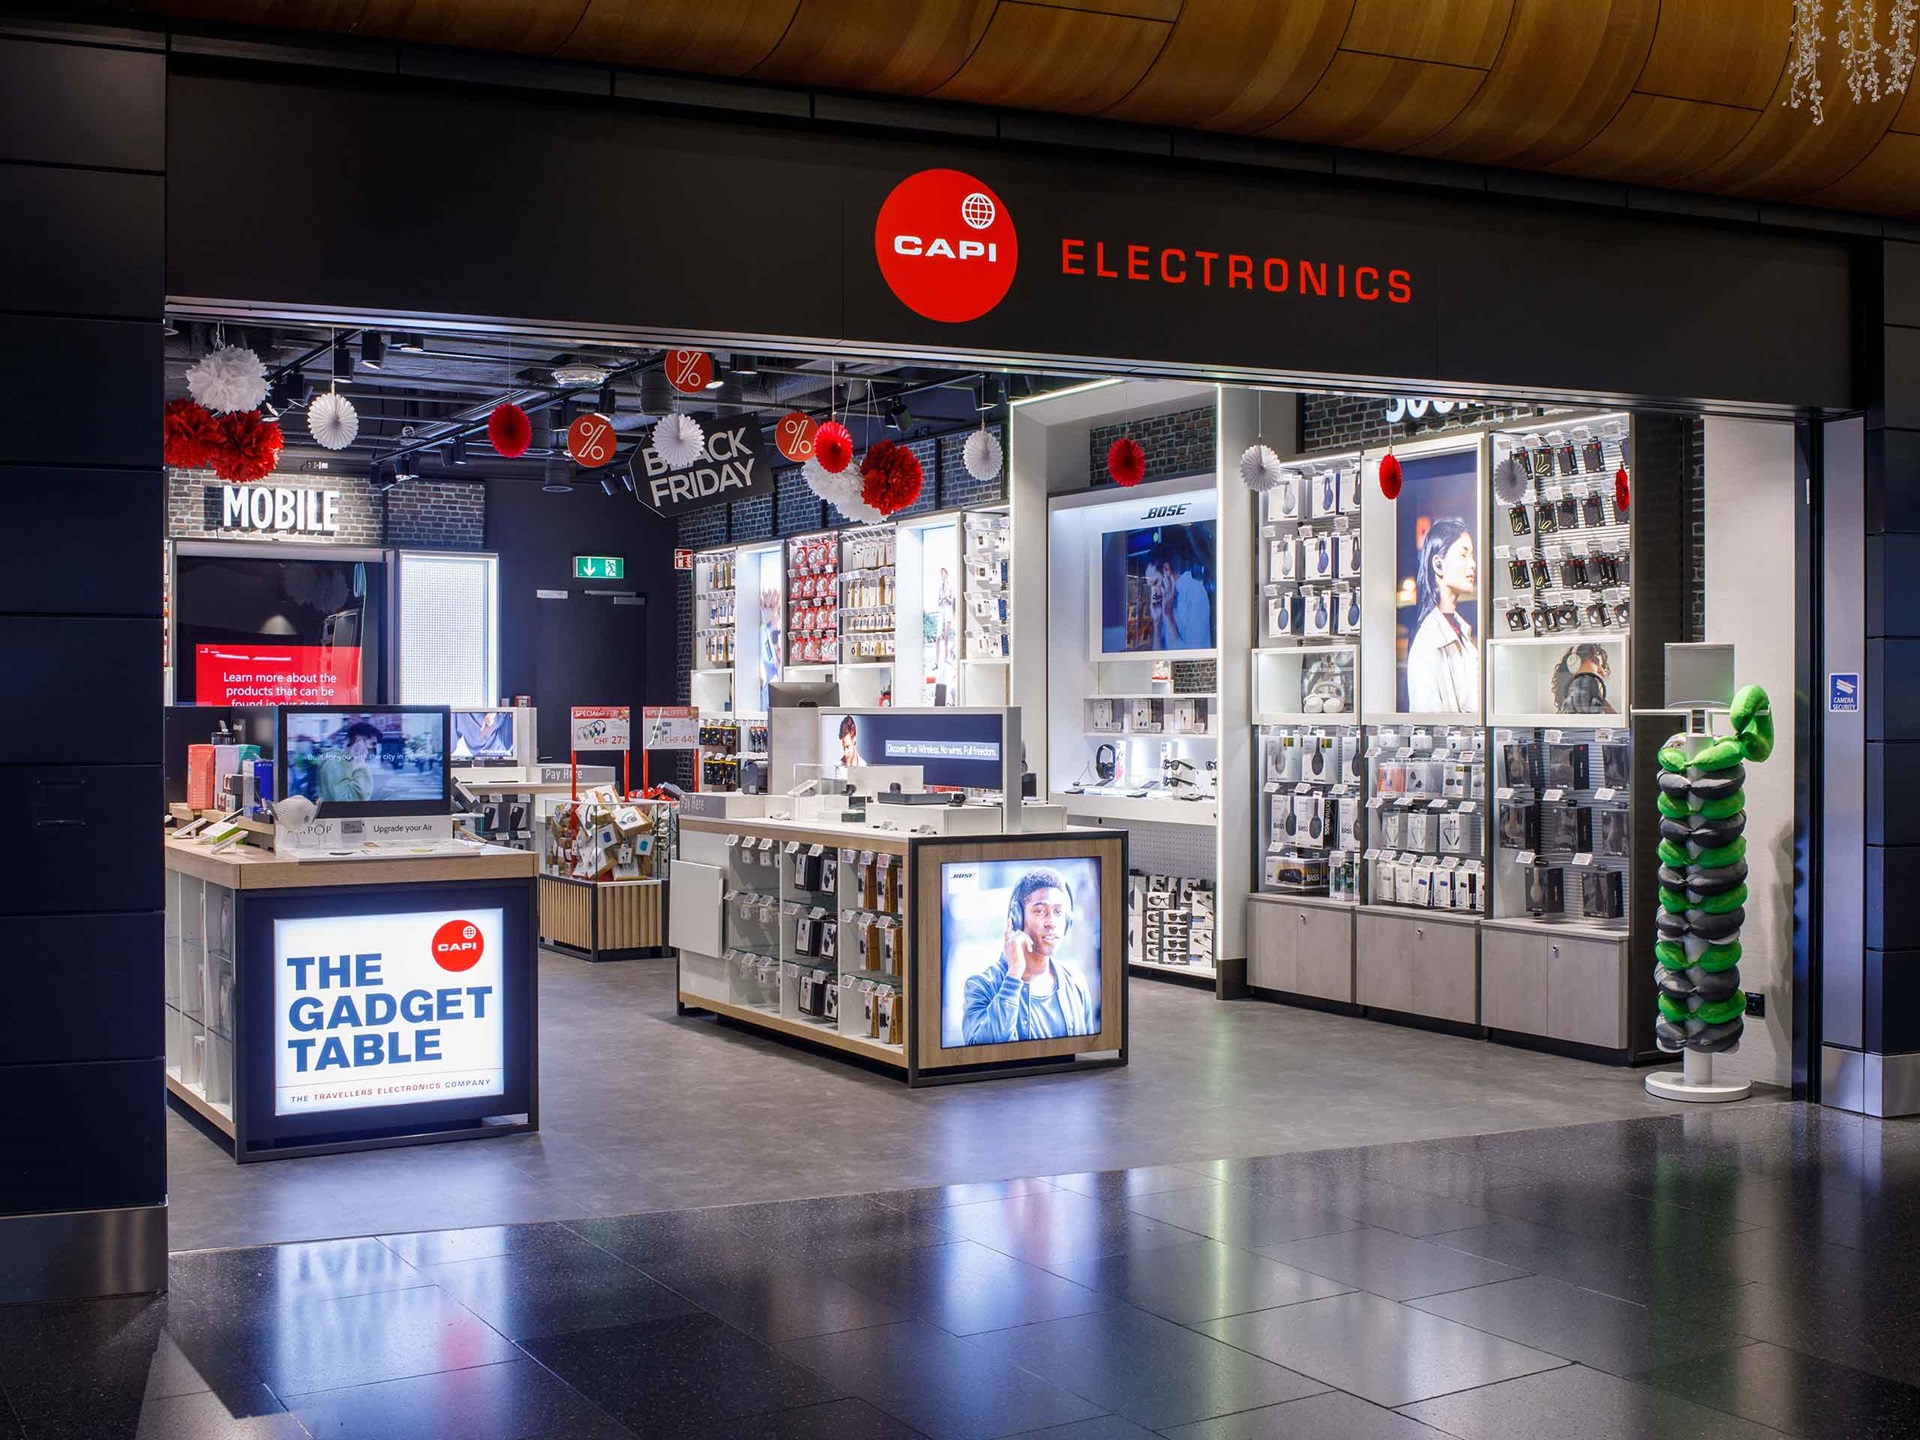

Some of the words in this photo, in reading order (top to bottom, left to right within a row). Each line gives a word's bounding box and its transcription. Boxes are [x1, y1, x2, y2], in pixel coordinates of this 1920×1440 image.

[894, 234, 996, 262] CAPI
[1061, 239, 1412, 303] ELECTRONICS
[642, 427, 753, 476] BCK
[650, 458, 755, 507] FRIDAY
[223, 485, 340, 531] MOBILE
[1141, 502, 1192, 520] BOSE
[223, 672, 252, 683] Learn
[256, 674, 283, 683] more
[286, 672, 317, 683] about
[320, 672, 337, 683] the
[226, 686, 273, 698] products
[276, 686, 297, 696] that
[300, 688, 318, 696] can
[321, 686, 334, 696] be
[594, 737, 609, 745] CHF
[383, 753, 396, 762] city
[545, 769, 561, 782] Pay
[563, 769, 583, 780] Hee
[691, 796, 704, 810] Here
[373, 824, 404, 834] Upgrade
[405, 825, 421, 834] your
[423, 824, 432, 832] Air
[437, 942, 477, 952] CAPI
[286, 953, 384, 991] THE
[288, 986, 492, 1032] GADGET
[287, 1028, 442, 1073] TABLE
[291, 1095, 309, 1104] THE
[313, 1089, 373, 1101] TRAVELLERS
[377, 1083, 441, 1095] ELECTRONICS
[445, 1078, 491, 1089] COMPANY
